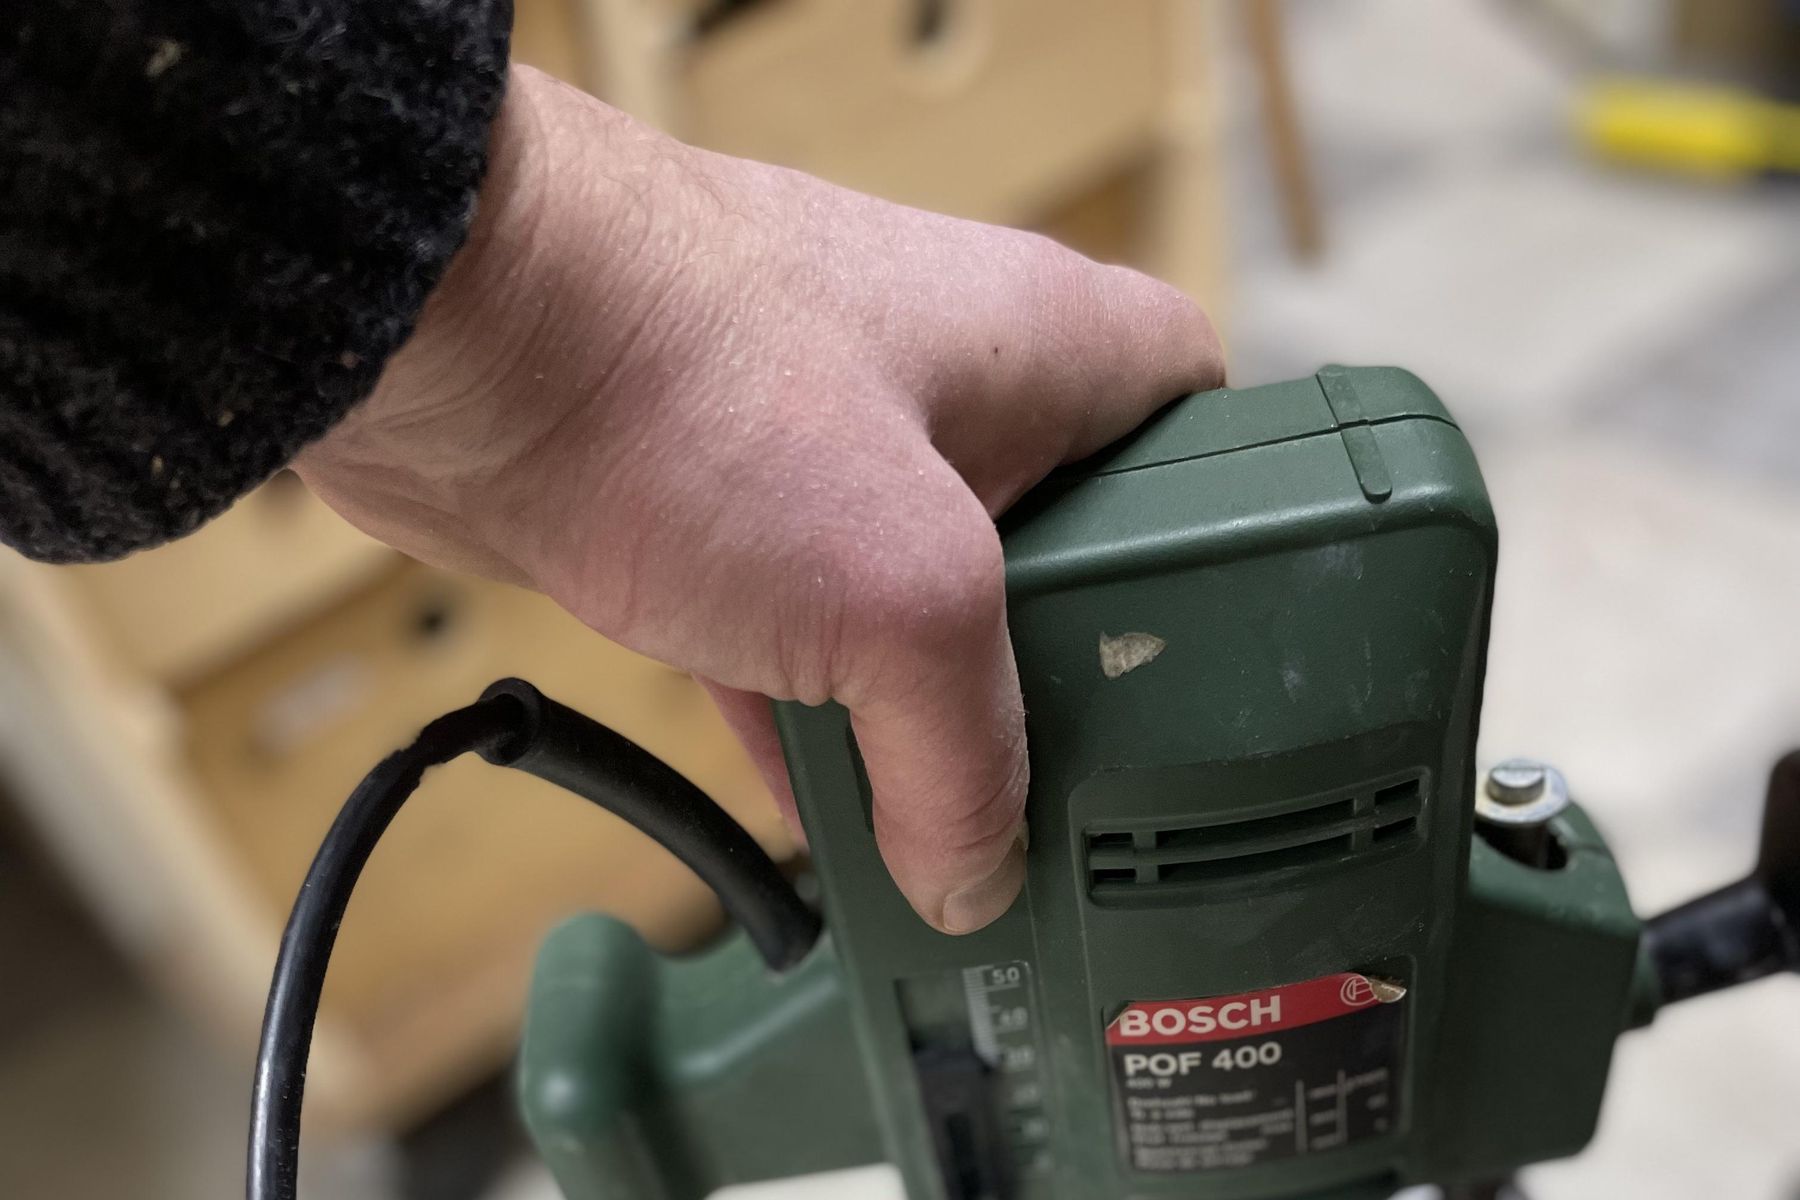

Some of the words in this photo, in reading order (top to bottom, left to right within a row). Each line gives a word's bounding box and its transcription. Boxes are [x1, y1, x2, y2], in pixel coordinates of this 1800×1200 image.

[1119, 994, 1281, 1037] BOSCH
[1123, 1051, 1202, 1077] POF
[1212, 1041, 1282, 1071] 400
